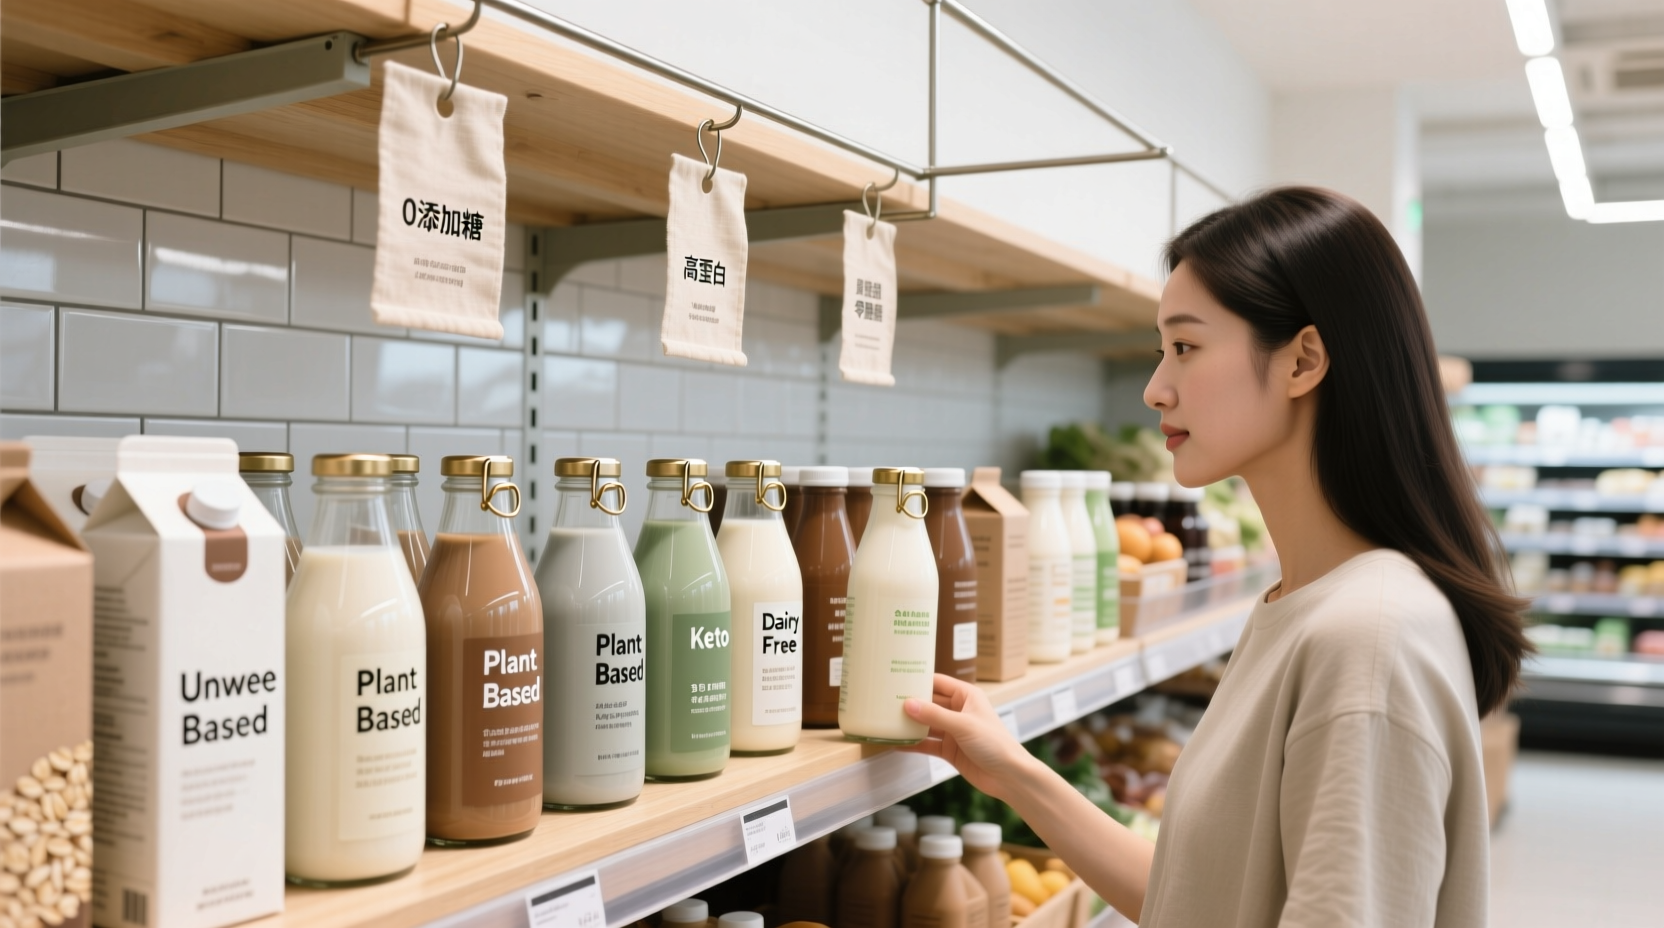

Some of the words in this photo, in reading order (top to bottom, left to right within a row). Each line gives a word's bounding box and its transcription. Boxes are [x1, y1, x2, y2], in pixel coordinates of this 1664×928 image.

[402, 197, 484, 241] 0添加糖
[761, 611, 800, 634] Dairy
[596, 633, 642, 656] Plant
[690, 626, 730, 650] Keto
[761, 636, 797, 655] Free
[483, 648, 538, 675] Plant
[595, 658, 644, 685] Based
[180, 671, 277, 702] Unwee
[357, 667, 417, 696] Plant
[482, 676, 541, 708] Based
[182, 705, 267, 746] Based
[357, 698, 421, 733] Based
